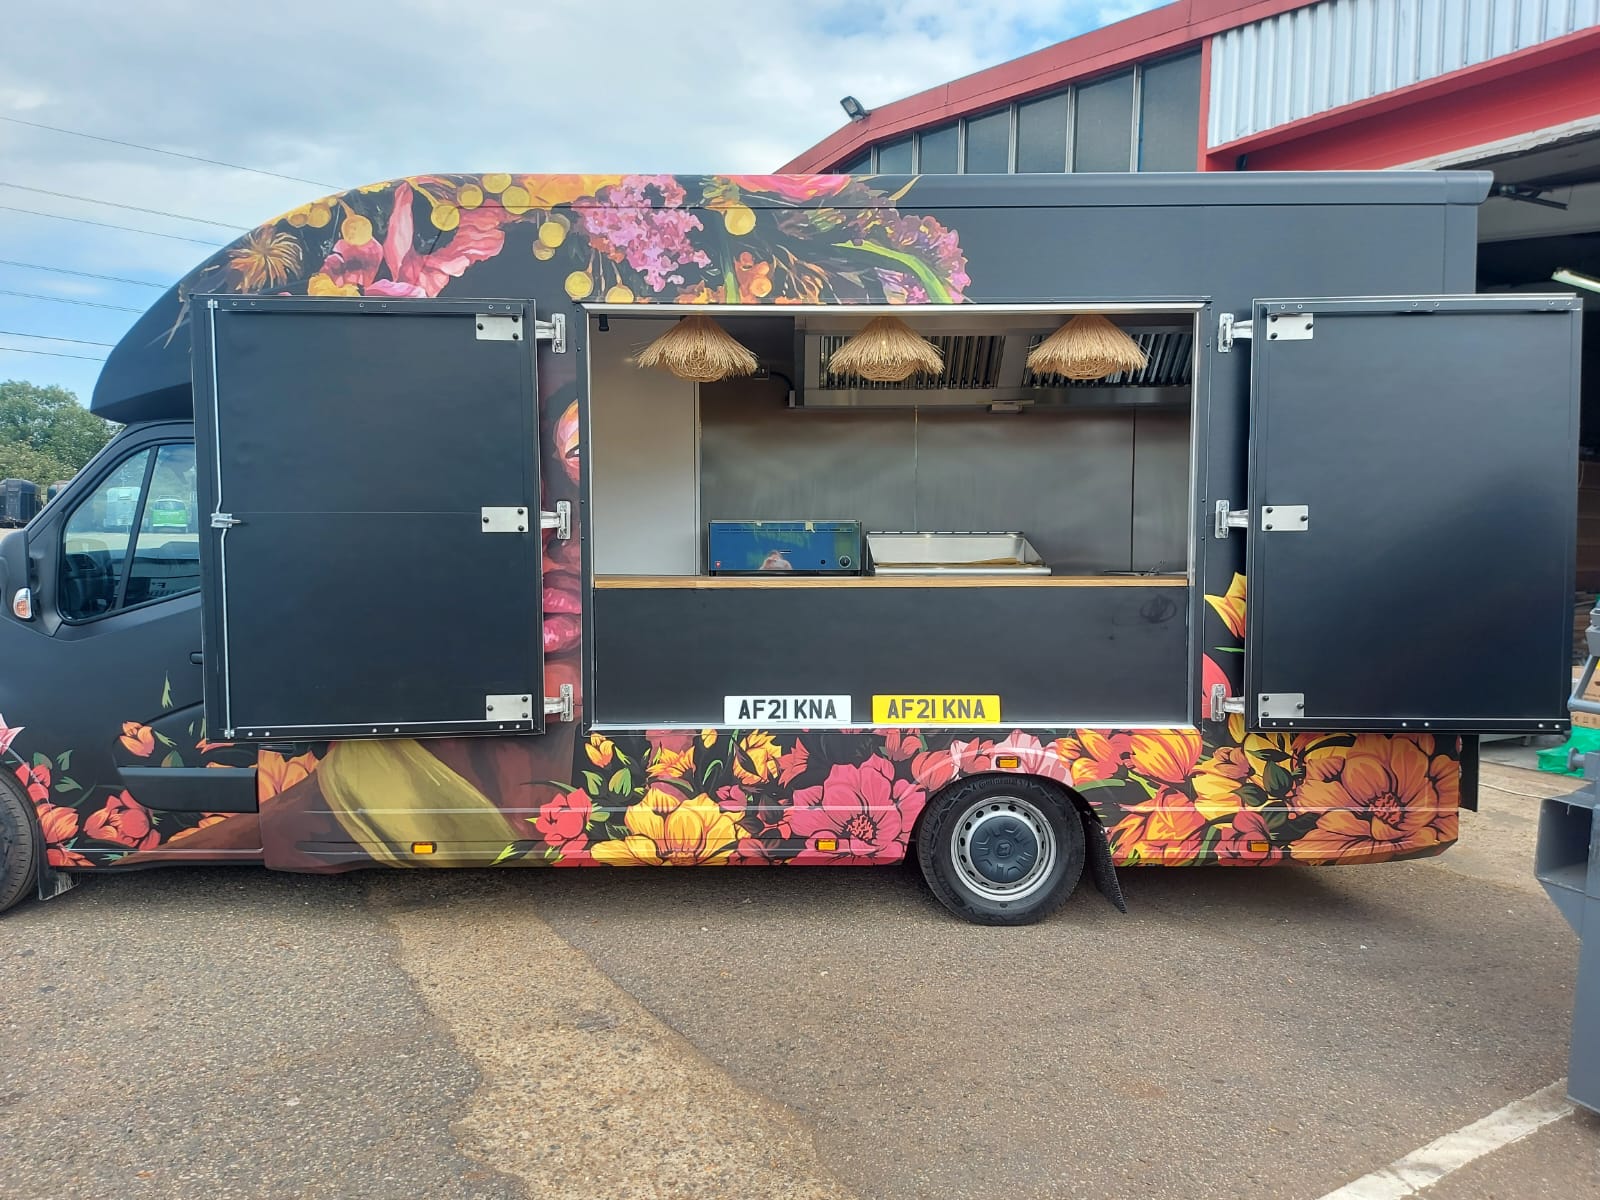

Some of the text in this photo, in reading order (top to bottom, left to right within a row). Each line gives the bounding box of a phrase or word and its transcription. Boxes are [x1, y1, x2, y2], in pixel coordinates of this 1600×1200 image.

[738, 699, 837, 720] AF21 KNA
[887, 699, 986, 719] AF21 KNA
